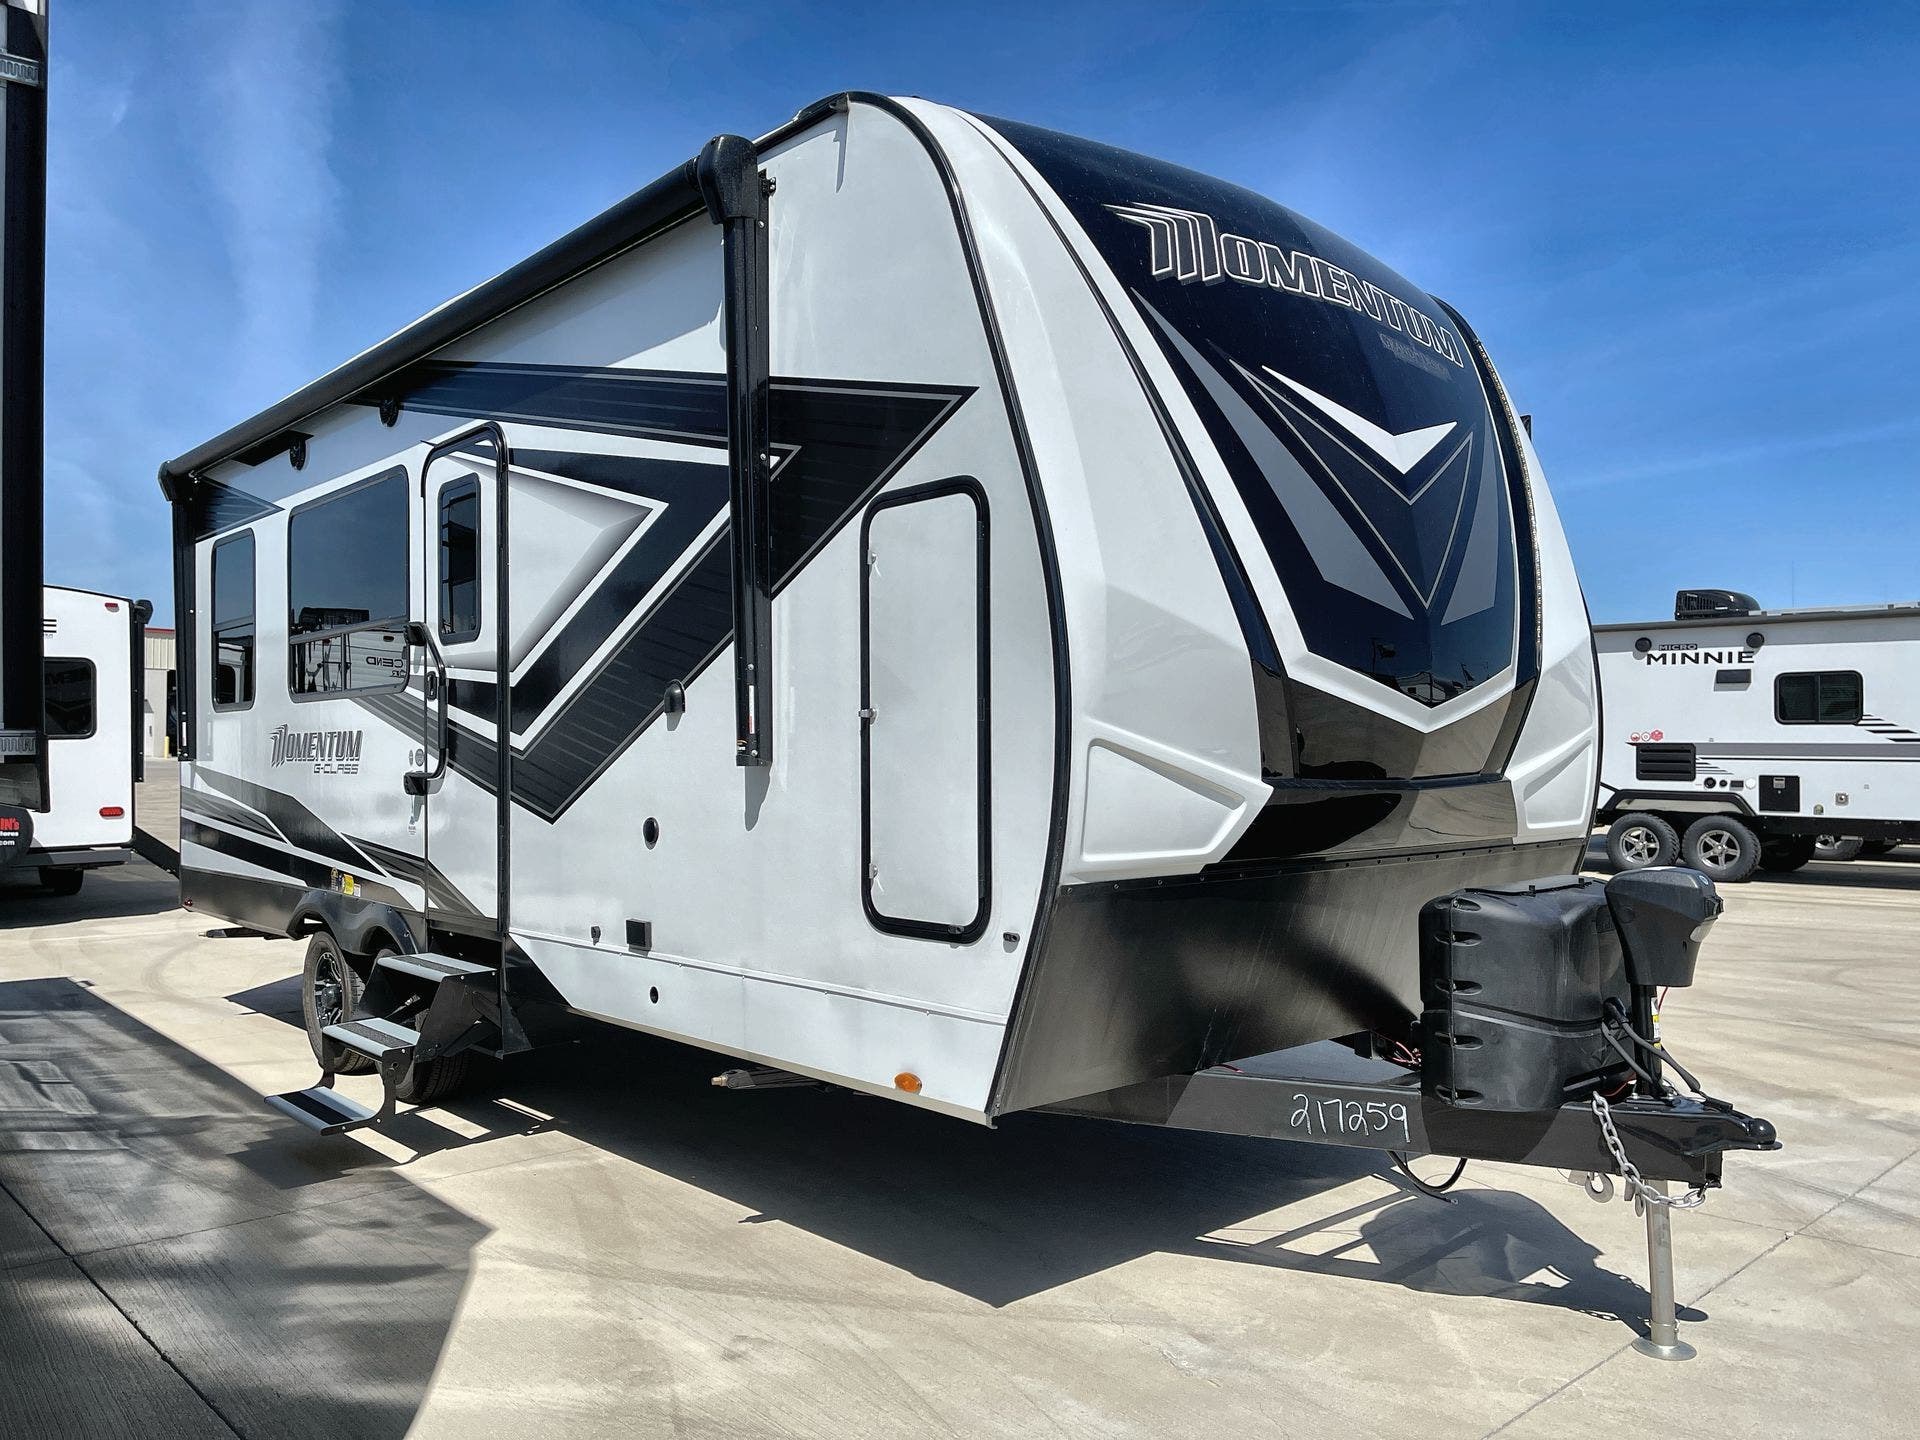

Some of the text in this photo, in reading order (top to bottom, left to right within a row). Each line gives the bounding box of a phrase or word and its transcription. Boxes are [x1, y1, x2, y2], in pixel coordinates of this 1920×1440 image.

[1101, 201, 1464, 368] MOMENTUM
[1647, 651, 1755, 665] MINNIE
[1658, 643, 1698, 651] MICRO
[268, 723, 363, 768] MOMENTUM
[313, 763, 360, 775] G-CLASS
[1290, 1093, 1411, 1143] 217259
